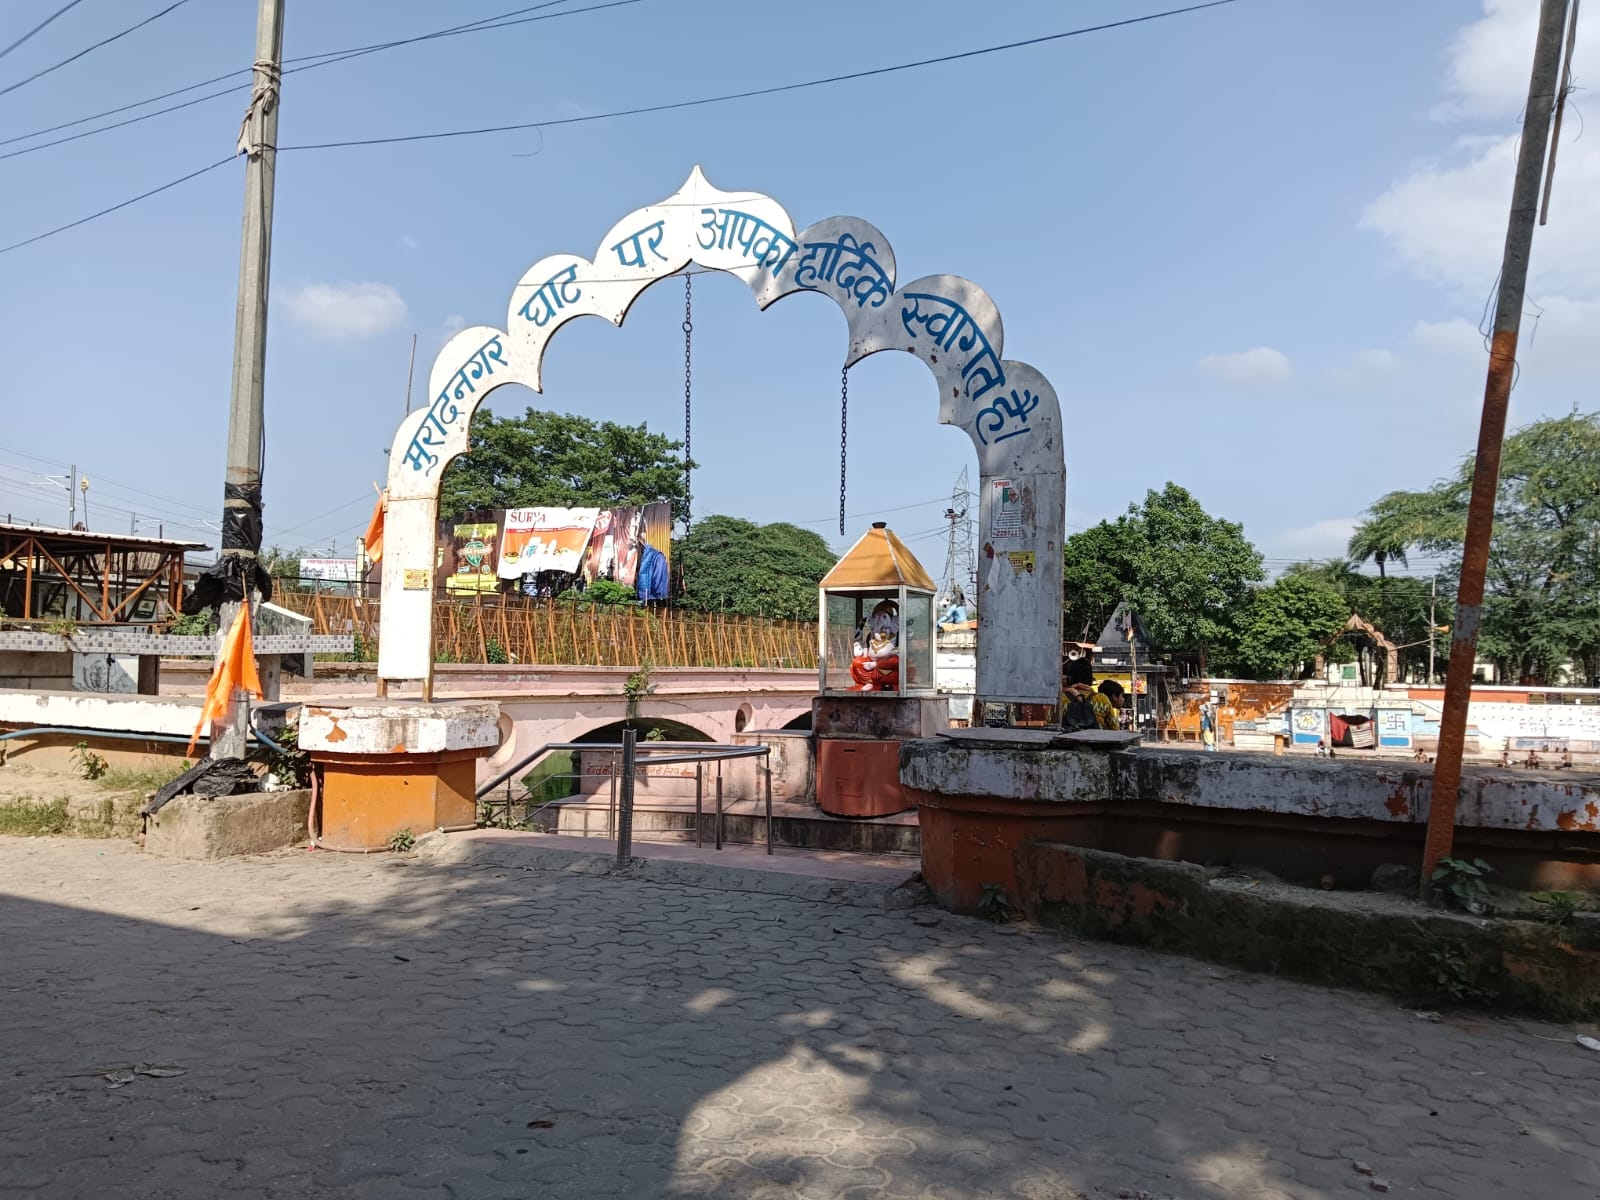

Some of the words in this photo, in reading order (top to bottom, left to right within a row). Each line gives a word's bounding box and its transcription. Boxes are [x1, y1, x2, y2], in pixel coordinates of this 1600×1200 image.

[402, 335, 509, 477] मुरादनगर
[518, 263, 581, 327] घाट
[610, 220, 668, 268] पर
[696, 208, 799, 278] आपका
[795, 233, 894, 308] हार्दिक
[902, 293, 1005, 401] स्वागत
